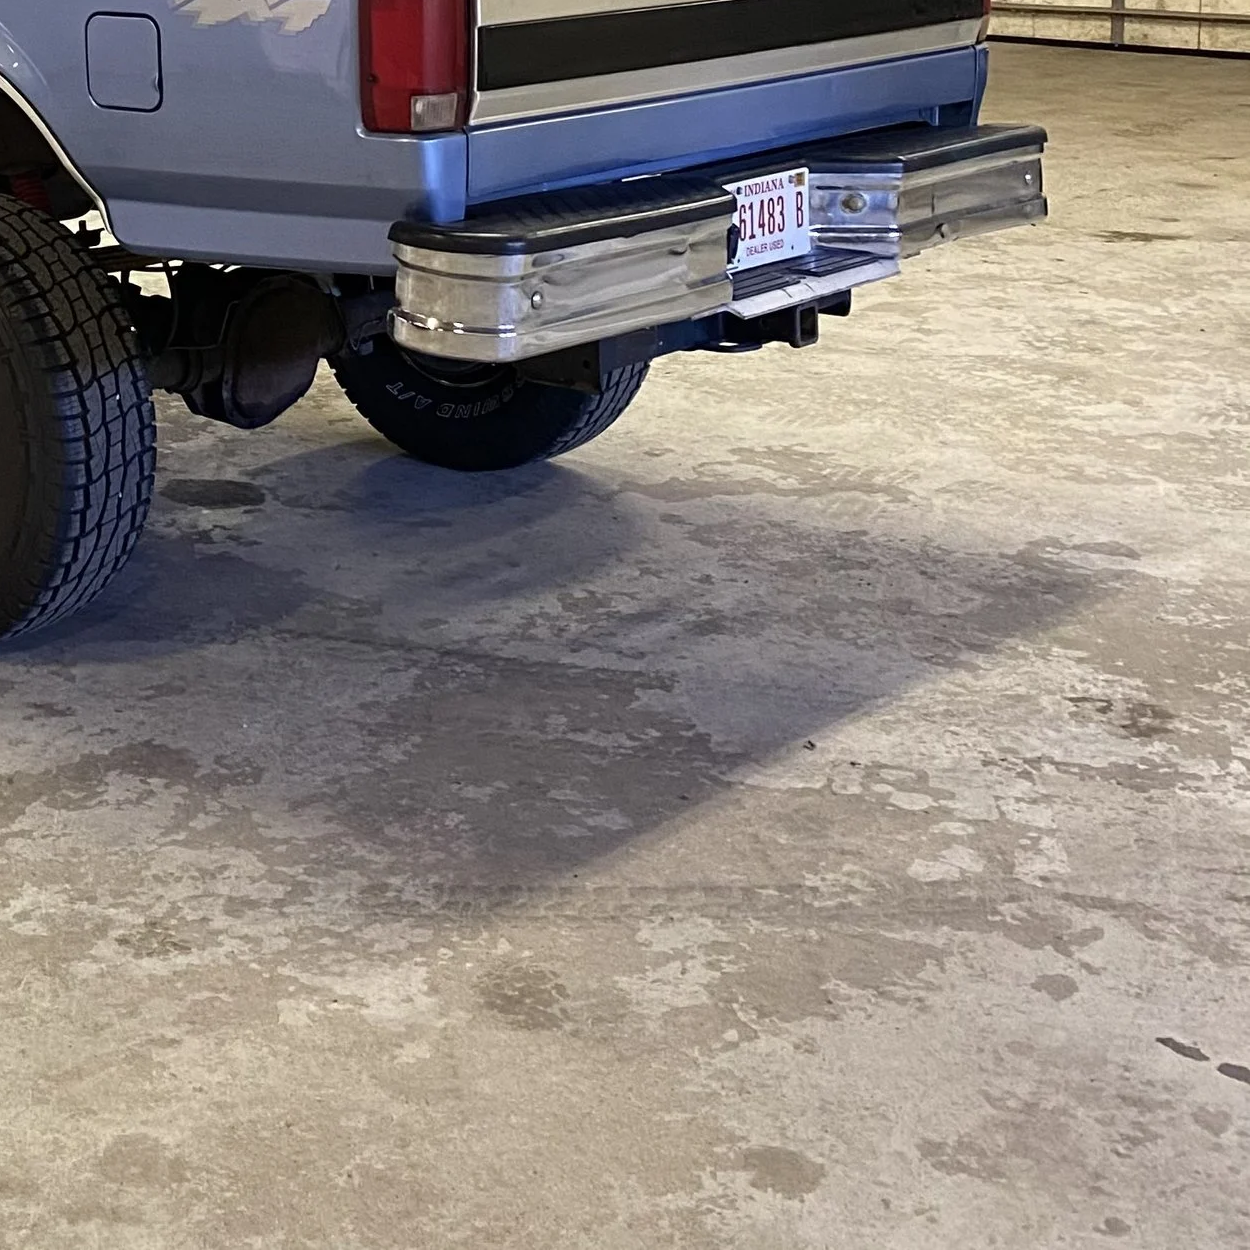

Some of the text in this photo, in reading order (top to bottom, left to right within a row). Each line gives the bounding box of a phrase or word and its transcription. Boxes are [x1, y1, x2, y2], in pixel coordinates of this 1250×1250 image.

[744, 178, 784, 197] INDIANA
[738, 191, 804, 242] 61483 B
[746, 239, 784, 257] DEALER USED
[385, 381, 433, 410] A/T
